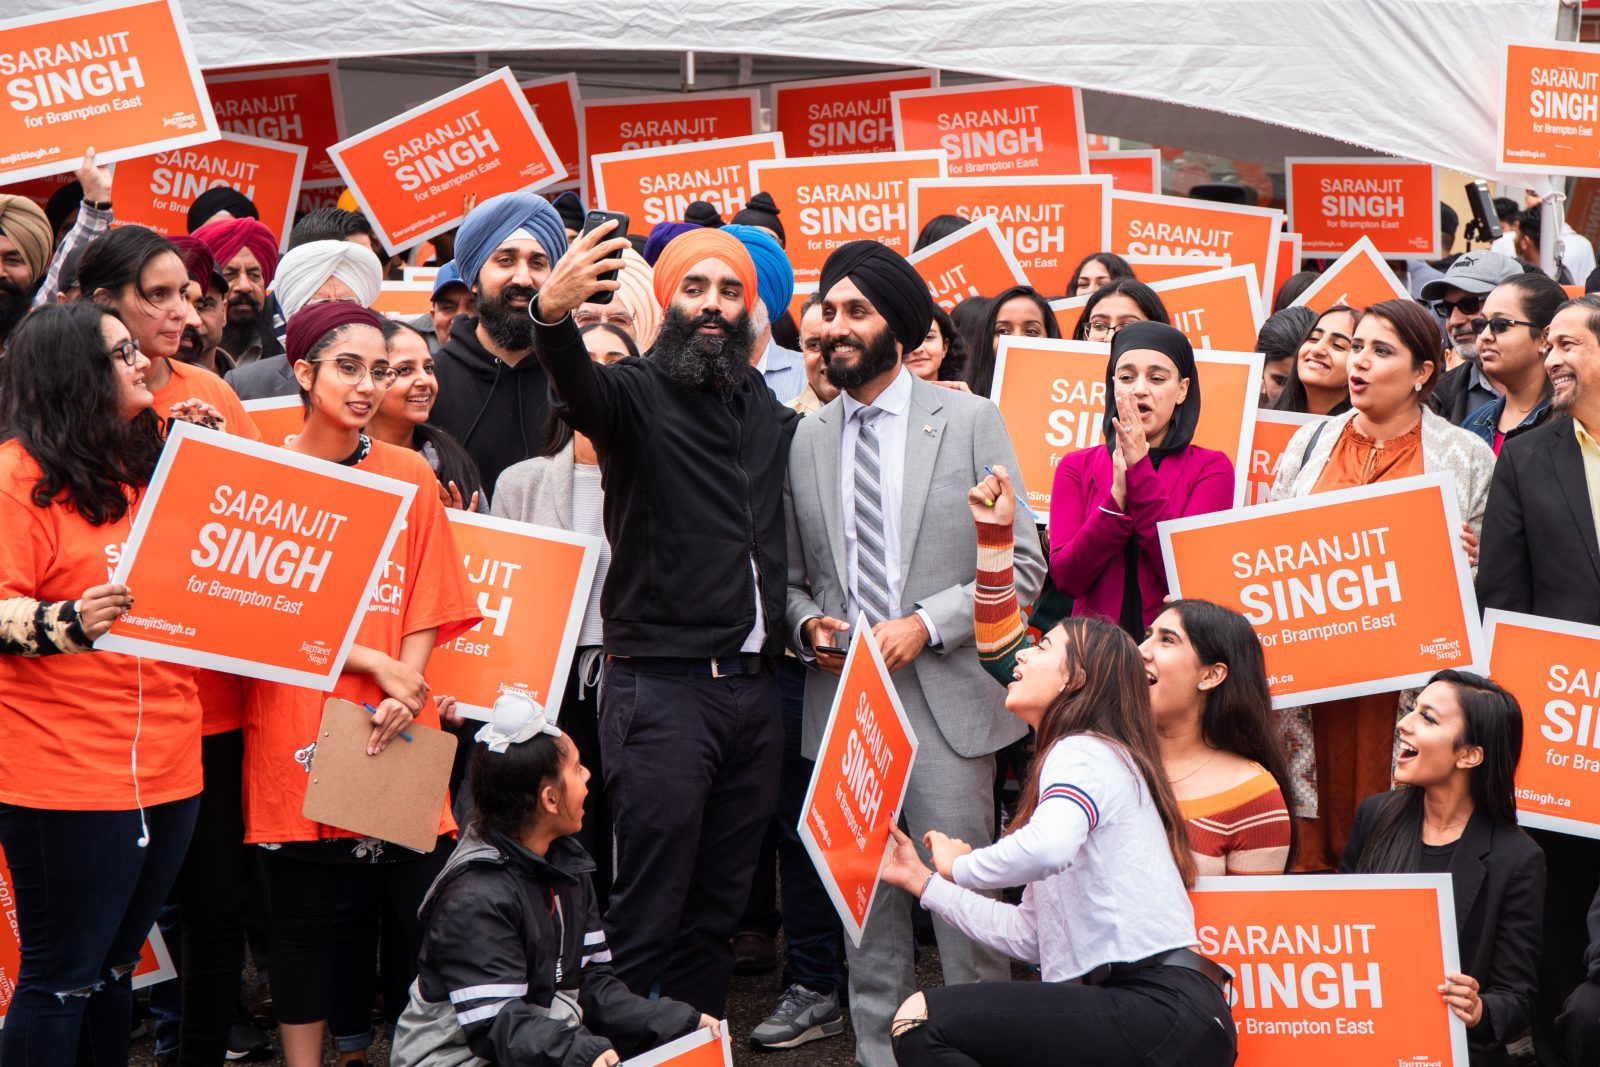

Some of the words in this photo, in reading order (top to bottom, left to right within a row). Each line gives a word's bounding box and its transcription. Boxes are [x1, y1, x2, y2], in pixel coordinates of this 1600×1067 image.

[0, 31, 130, 75] SARANJIT
[6, 56, 145, 111] SINGH
[1530, 67, 1599, 90] SARANJIT
[24, 115, 43, 128] for
[45, 102, 111, 124] Brampton
[112, 95, 143, 111] East
[213, 94, 298, 117] ARANJIT
[808, 97, 891, 120] SARANJI
[937, 105, 1039, 131] SARANJIT
[1529, 89, 1598, 122] SINGH
[382, 110, 482, 167] SARANJIT
[620, 117, 718, 138] SARANJIT
[940, 126, 1044, 160] SINGH
[155, 150, 260, 181] SARANJIT
[394, 129, 501, 191] SINGH
[949, 164, 963, 174] for
[965, 161, 1015, 172] Brampton
[1016, 158, 1039, 168] East
[414, 189, 429, 202] for
[429, 168, 478, 196] Brampton
[478, 158, 501, 174] East
[639, 165, 741, 194] SARANJIT
[797, 180, 903, 204] SARANJIT
[1320, 178, 1404, 193] SARANJIT
[152, 198, 167, 210] for
[1322, 195, 1405, 218] SINGH
[800, 203, 906, 235] SINGH
[1327, 219, 1339, 228] for
[1340, 220, 1380, 230] Brampton
[1381, 220, 1399, 229] East
[807, 239, 822, 251] for
[1128, 219, 1234, 249] SARANJIT
[1034, 257, 1058, 268] East
[209, 485, 347, 542] SARANJIT
[190, 523, 333, 593] SINGH
[1231, 527, 1390, 579] SARANJIT
[186, 574, 205, 594] for
[207, 579, 274, 608] Brampton
[274, 594, 304, 615] East
[1239, 560, 1402, 627] SINGH
[120, 612, 196, 636] SaranjitSingh.ca
[1257, 634, 1278, 648] for
[1281, 621, 1359, 644] Brampton
[1361, 612, 1397, 631] East
[454, 637, 491, 657] East
[1419, 639, 1460, 656] Jagmeet
[1436, 648, 1462, 660] Singh
[855, 691, 894, 780] SARANJIT
[1545, 749, 1569, 767] for
[842, 728, 884, 832] SINGH
[1514, 787, 1571, 807] itSingh.ca
[1198, 924, 1376, 956] SARANJIT
[1246, 1017, 1331, 1038] Brampton
[1336, 1017, 1375, 1034] East
